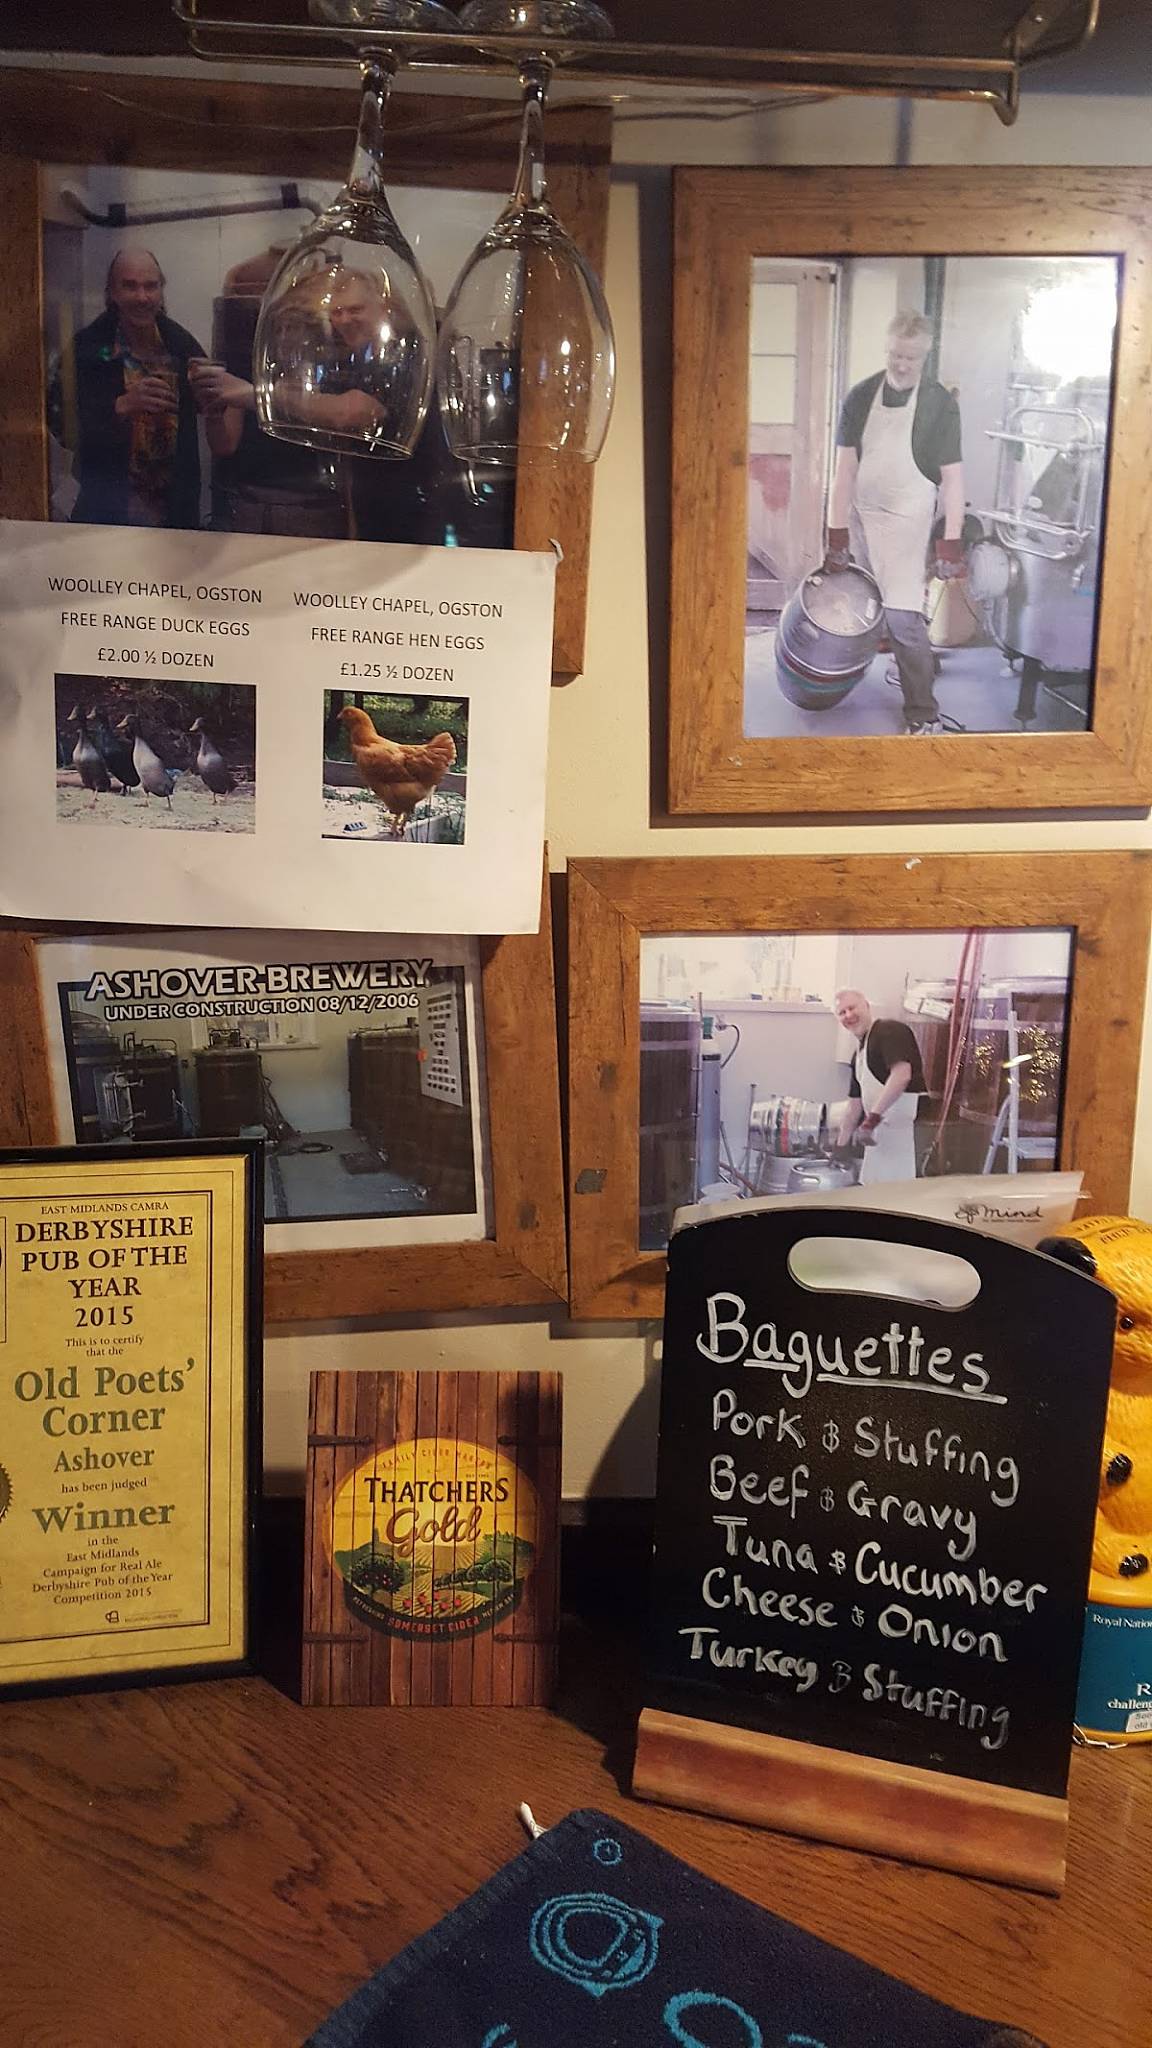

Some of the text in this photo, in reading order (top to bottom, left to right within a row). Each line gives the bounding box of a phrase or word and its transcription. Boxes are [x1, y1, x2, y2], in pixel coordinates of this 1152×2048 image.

[48, 577, 262, 603] WOOLLEY CHAPEL, OGSTON
[294, 592, 503, 618] WOOLLEY CHAPEL, OGSTON
[61, 612, 250, 636] FREE RANGE DUCK EGGS
[311, 627, 484, 650] FREE RANGE HEN EGGS
[97, 648, 140, 663] £2.00
[161, 652, 214, 667] DOZEN
[340, 663, 381, 677] £1.25
[403, 666, 454, 682] DOZEN
[84, 958, 433, 1000] ASHOVER BREWERY
[104, 993, 420, 1021] UNDER CONSTRUCTION 08/12/2006
[41, 1201, 169, 1215] EAST MIDLANDS CAMRA
[15, 1216, 193, 1243] DERBYSHIRE
[21, 1245, 187, 1272] PUB OF THE
[68, 1277, 142, 1299] YEAR
[75, 1306, 134, 1327] 2015
[65, 1335, 144, 1348] This is to certify
[86, 1347, 124, 1357] that the
[696, 1292, 991, 1398] Baguettes
[15, 1366, 80, 1402] Old
[42, 1406, 166, 1437] Corner
[54, 1447, 155, 1473] Ashover
[712, 1388, 806, 1449] Pork
[854, 1416, 1020, 1508] Stuffing
[61, 1478, 147, 1494] has been judged
[364, 1477, 509, 1503] THATCHERS
[32, 1501, 175, 1534] Winner
[710, 1454, 810, 1519] Beef
[847, 1480, 977, 1562] Gravy
[87, 1535, 119, 1547] in the
[386, 1505, 483, 1558] Gold
[66, 1547, 140, 1563] East Midlands
[712, 1515, 819, 1575] Tuna
[855, 1540, 1049, 1614] Cucumber
[43, 1559, 162, 1579] Campaign for Real Ale
[32, 1572, 173, 1594] Derbyshire Pub of the Year
[53, 1588, 152, 1606] Competition 2015
[387, 1615, 444, 1634] SOMERSET
[447, 1616, 480, 1633] CIDER
[701, 1567, 840, 1629] Cheese
[877, 1603, 1008, 1663] Onion
[1093, 1613, 1122, 1629] Royal
[678, 1626, 819, 1692] Turkey
[862, 1663, 1011, 1751] Stuffing
